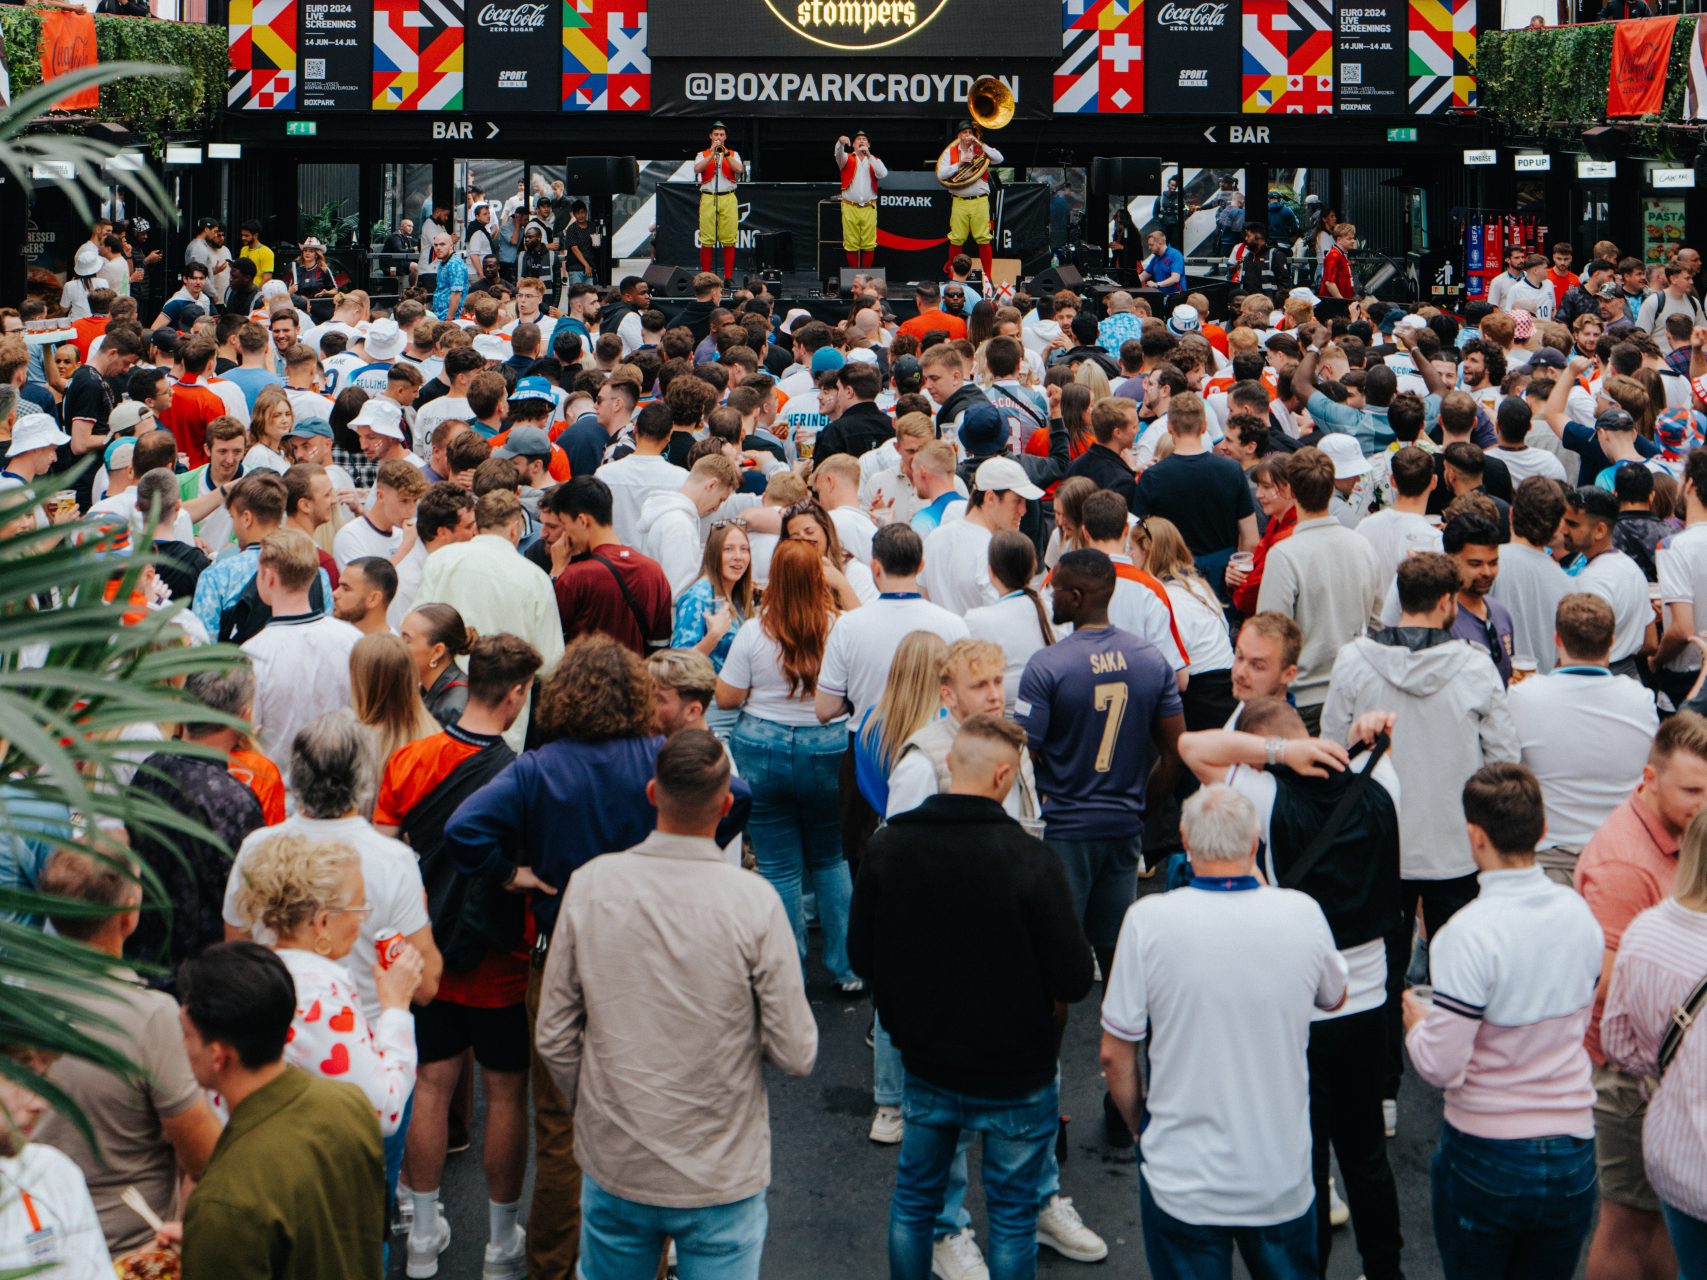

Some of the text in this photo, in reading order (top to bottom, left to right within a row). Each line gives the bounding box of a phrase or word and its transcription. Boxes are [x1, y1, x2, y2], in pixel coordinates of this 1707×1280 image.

[306, 4, 352, 12] EURO 2024
[1341, 8, 1386, 16] EURO 2024
[306, 12, 324, 20] LIVE
[1341, 16, 1359, 24] LIVE
[305, 20, 356, 28] SCREENINGS
[1341, 24, 1391, 32] SCREENINGS
[499, 71, 527, 80] SPORT
[1180, 69, 1208, 79] SPORT
[684, 72, 1020, 103] @BOXPARKCROYDN
[1341, 103, 1372, 111] BOXPARK
[432, 121, 474, 140] BAR
[1229, 126, 1271, 144] BAR
[1517, 158, 1547, 167] POP UP
[880, 195, 932, 208] BOXPARK
[1539, 305, 1549, 318] 10
[788, 412, 831, 427] HERING
[1089, 650, 1128, 675] SAKA
[1094, 681, 1129, 773] 7
